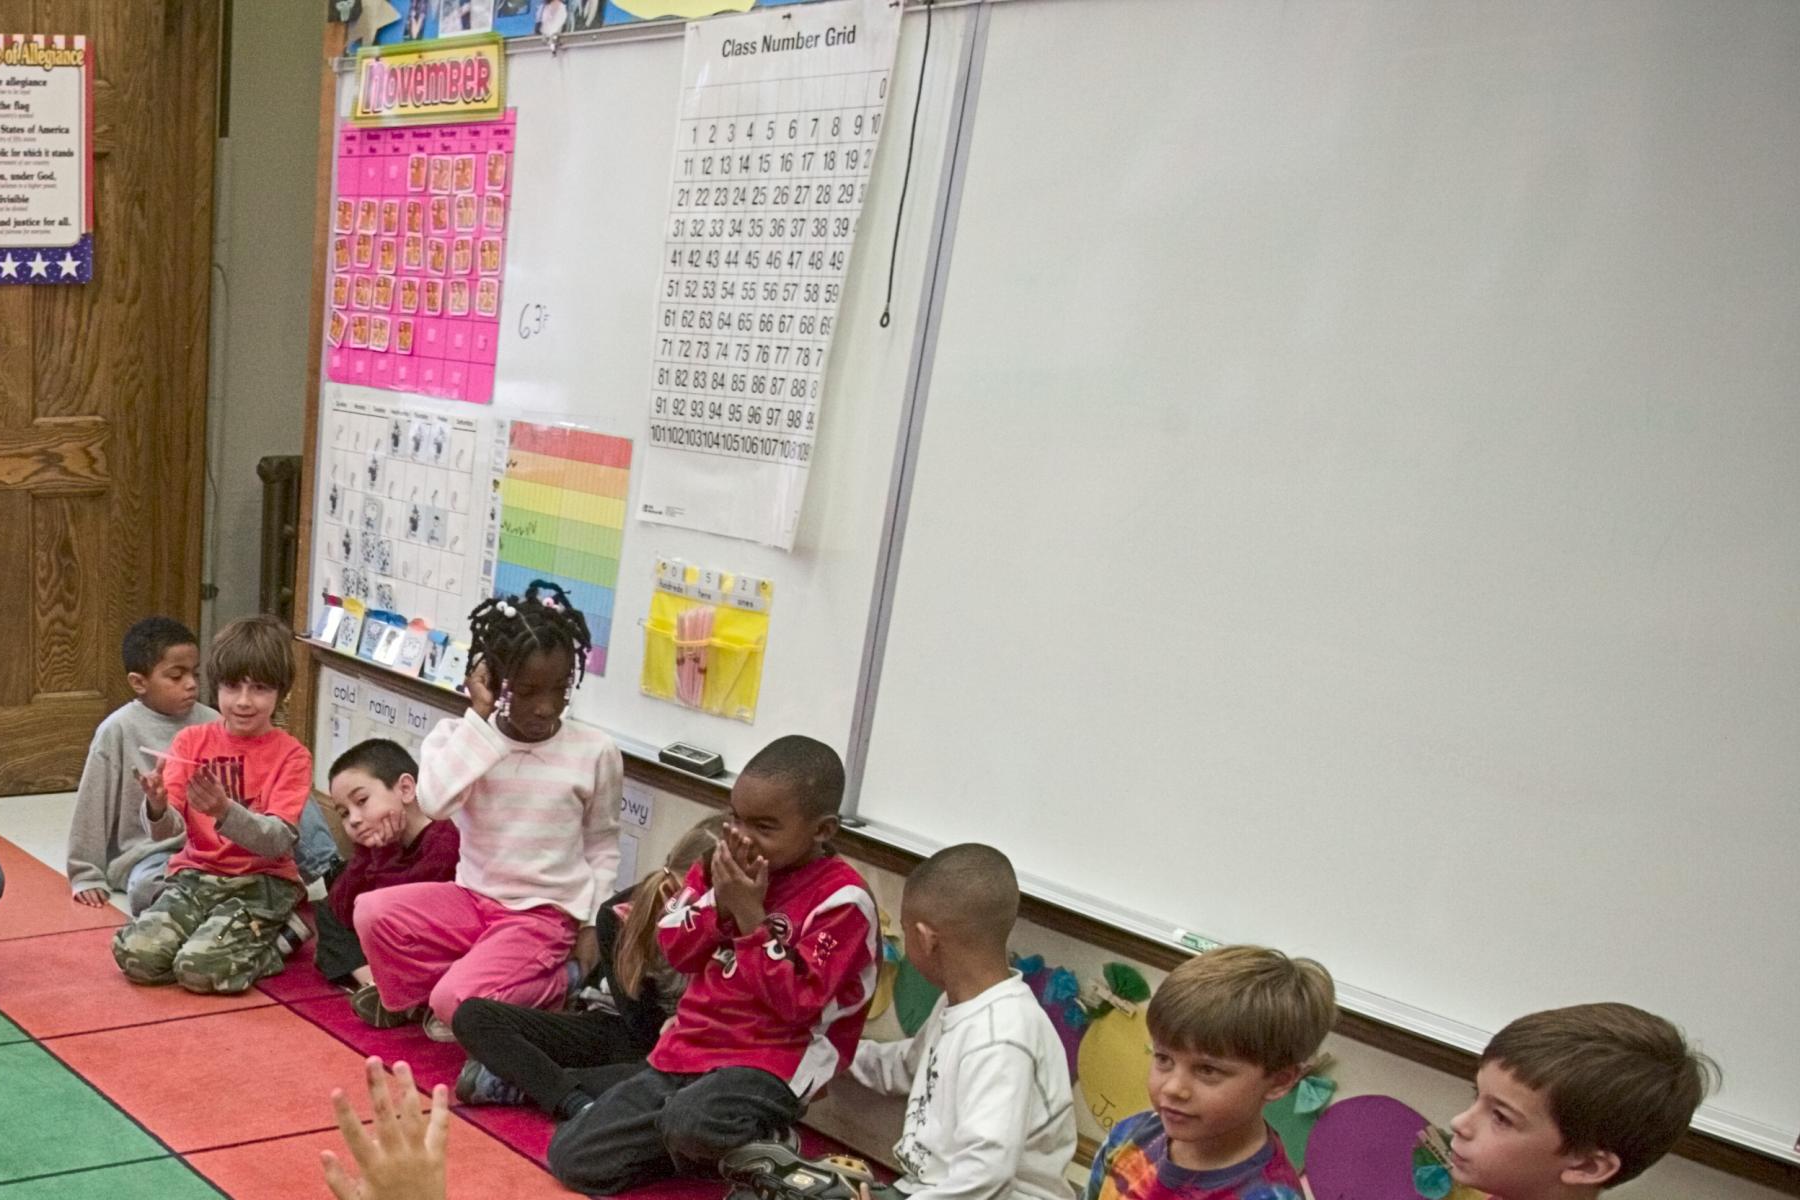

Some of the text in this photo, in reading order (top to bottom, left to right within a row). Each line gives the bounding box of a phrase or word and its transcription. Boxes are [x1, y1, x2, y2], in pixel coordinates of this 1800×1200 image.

[722, 25, 856, 57] Class Number Grid
[21, 41, 85, 71] Allegiance
[6, 77, 47, 88] allegiance
[880, 78, 887, 99] 0
[14, 101, 30, 112] flag
[1, 125, 25, 134] States
[38, 125, 70, 134] America
[693, 115, 862, 144] 1 2 3 4 5 6 7 8 9
[684, 149, 859, 176] 11 12 13 14 15 16 17 18 19
[678, 184, 854, 207] 21 22 23 24 25 26 27 28 29
[13, 218, 40, 228] justice
[673, 218, 849, 238] 31 32 33 34 35 36 37 38 39
[671, 250, 844, 271] 41 42 43 44 45 46 47 48 49
[667, 280, 819, 303] 51 52 53 54 55 56 57 58
[665, 309, 814, 334] 61 62 63 64 65 66 67 68
[662, 339, 810, 366] 71 72 73 74 75 76 77 78
[658, 368, 806, 398] 81 82 83 84 85 86 87 88
[656, 397, 801, 428] 91 92 93 94 95 96 97 98
[333, 684, 356, 704] cold
[368, 698, 397, 724] rainy
[408, 706, 428, 729] hot
